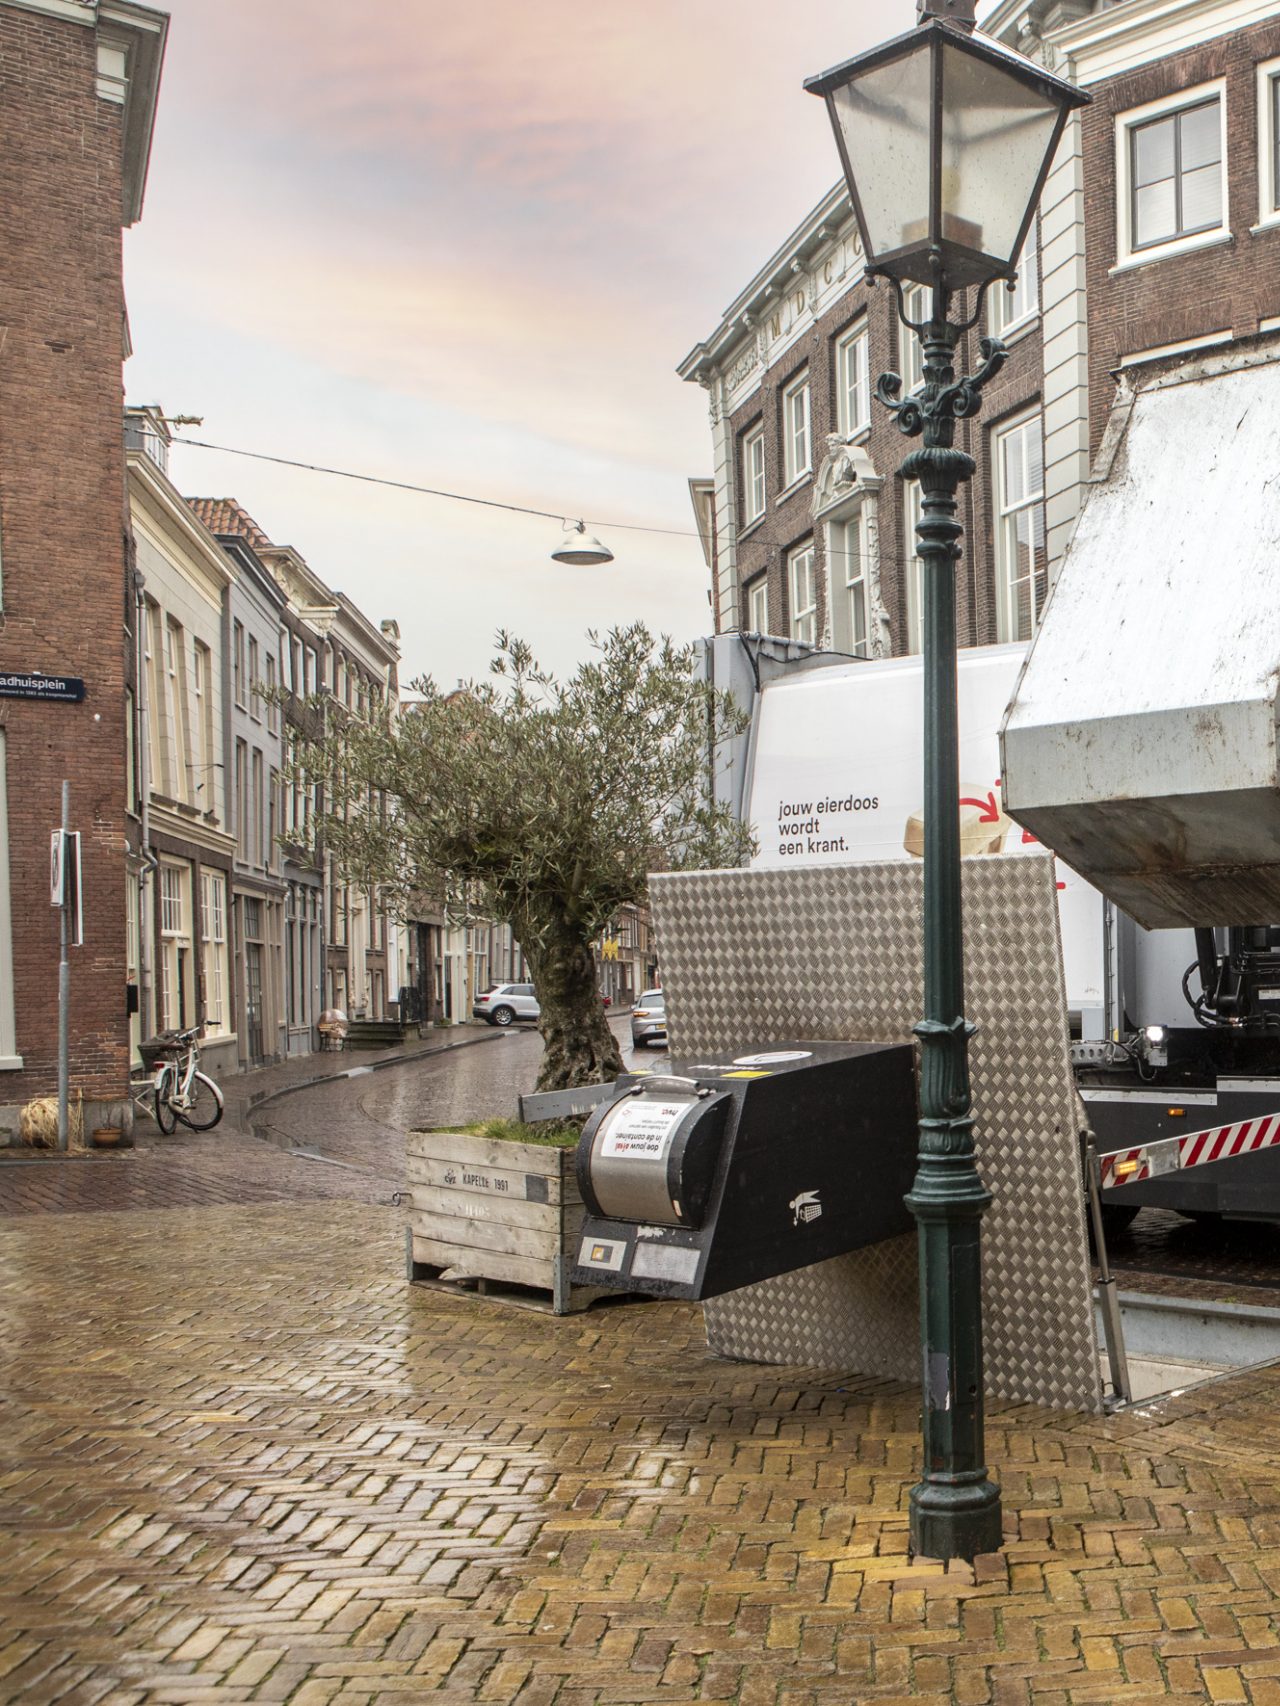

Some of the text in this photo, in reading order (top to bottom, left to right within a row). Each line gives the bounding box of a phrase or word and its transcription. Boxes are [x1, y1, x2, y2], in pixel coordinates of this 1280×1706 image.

[770, 312, 782, 341] M
[796, 289, 806, 316] D
[823, 260, 833, 285] C
[778, 794, 879, 821] jouw eierdoos
[778, 817, 820, 836] wordt
[779, 836, 849, 855] een krant.
[630, 1141, 647, 1152] jouw
[646, 1134, 655, 1142] de
[646, 1144, 659, 1152] doe
